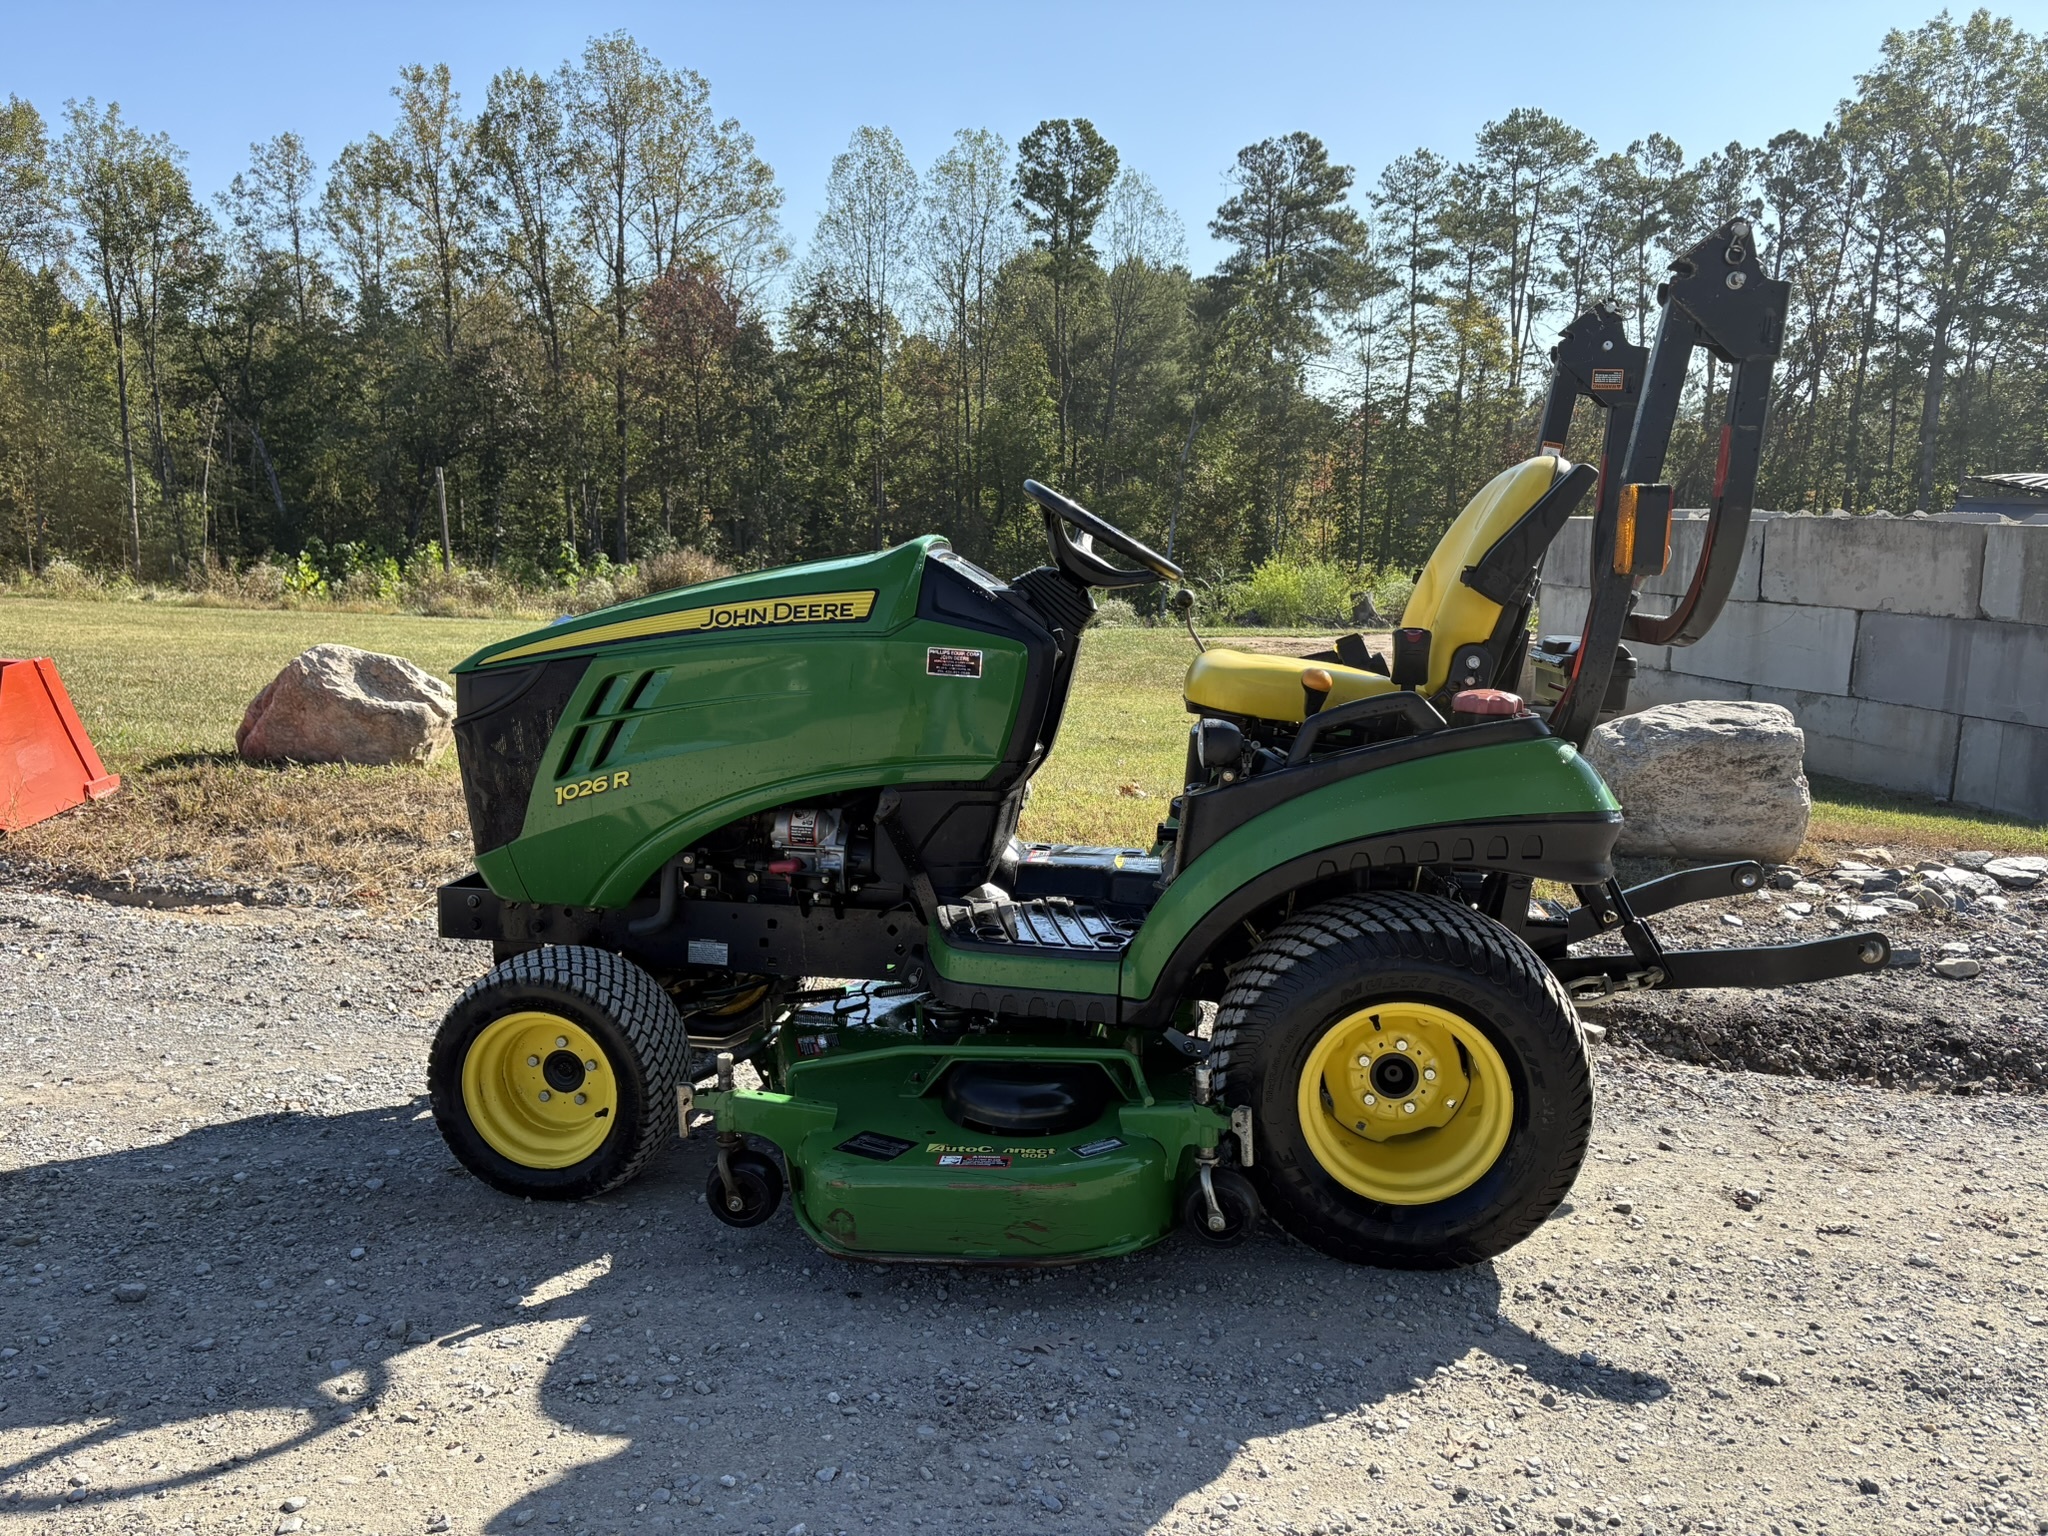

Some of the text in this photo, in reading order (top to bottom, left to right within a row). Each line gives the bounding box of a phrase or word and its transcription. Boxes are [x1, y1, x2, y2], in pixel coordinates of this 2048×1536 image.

[700, 602, 855, 628] JOHN DEERE
[554, 770, 630, 806] 1026 R
[925, 1143, 1057, 1155] AutoCnnect
